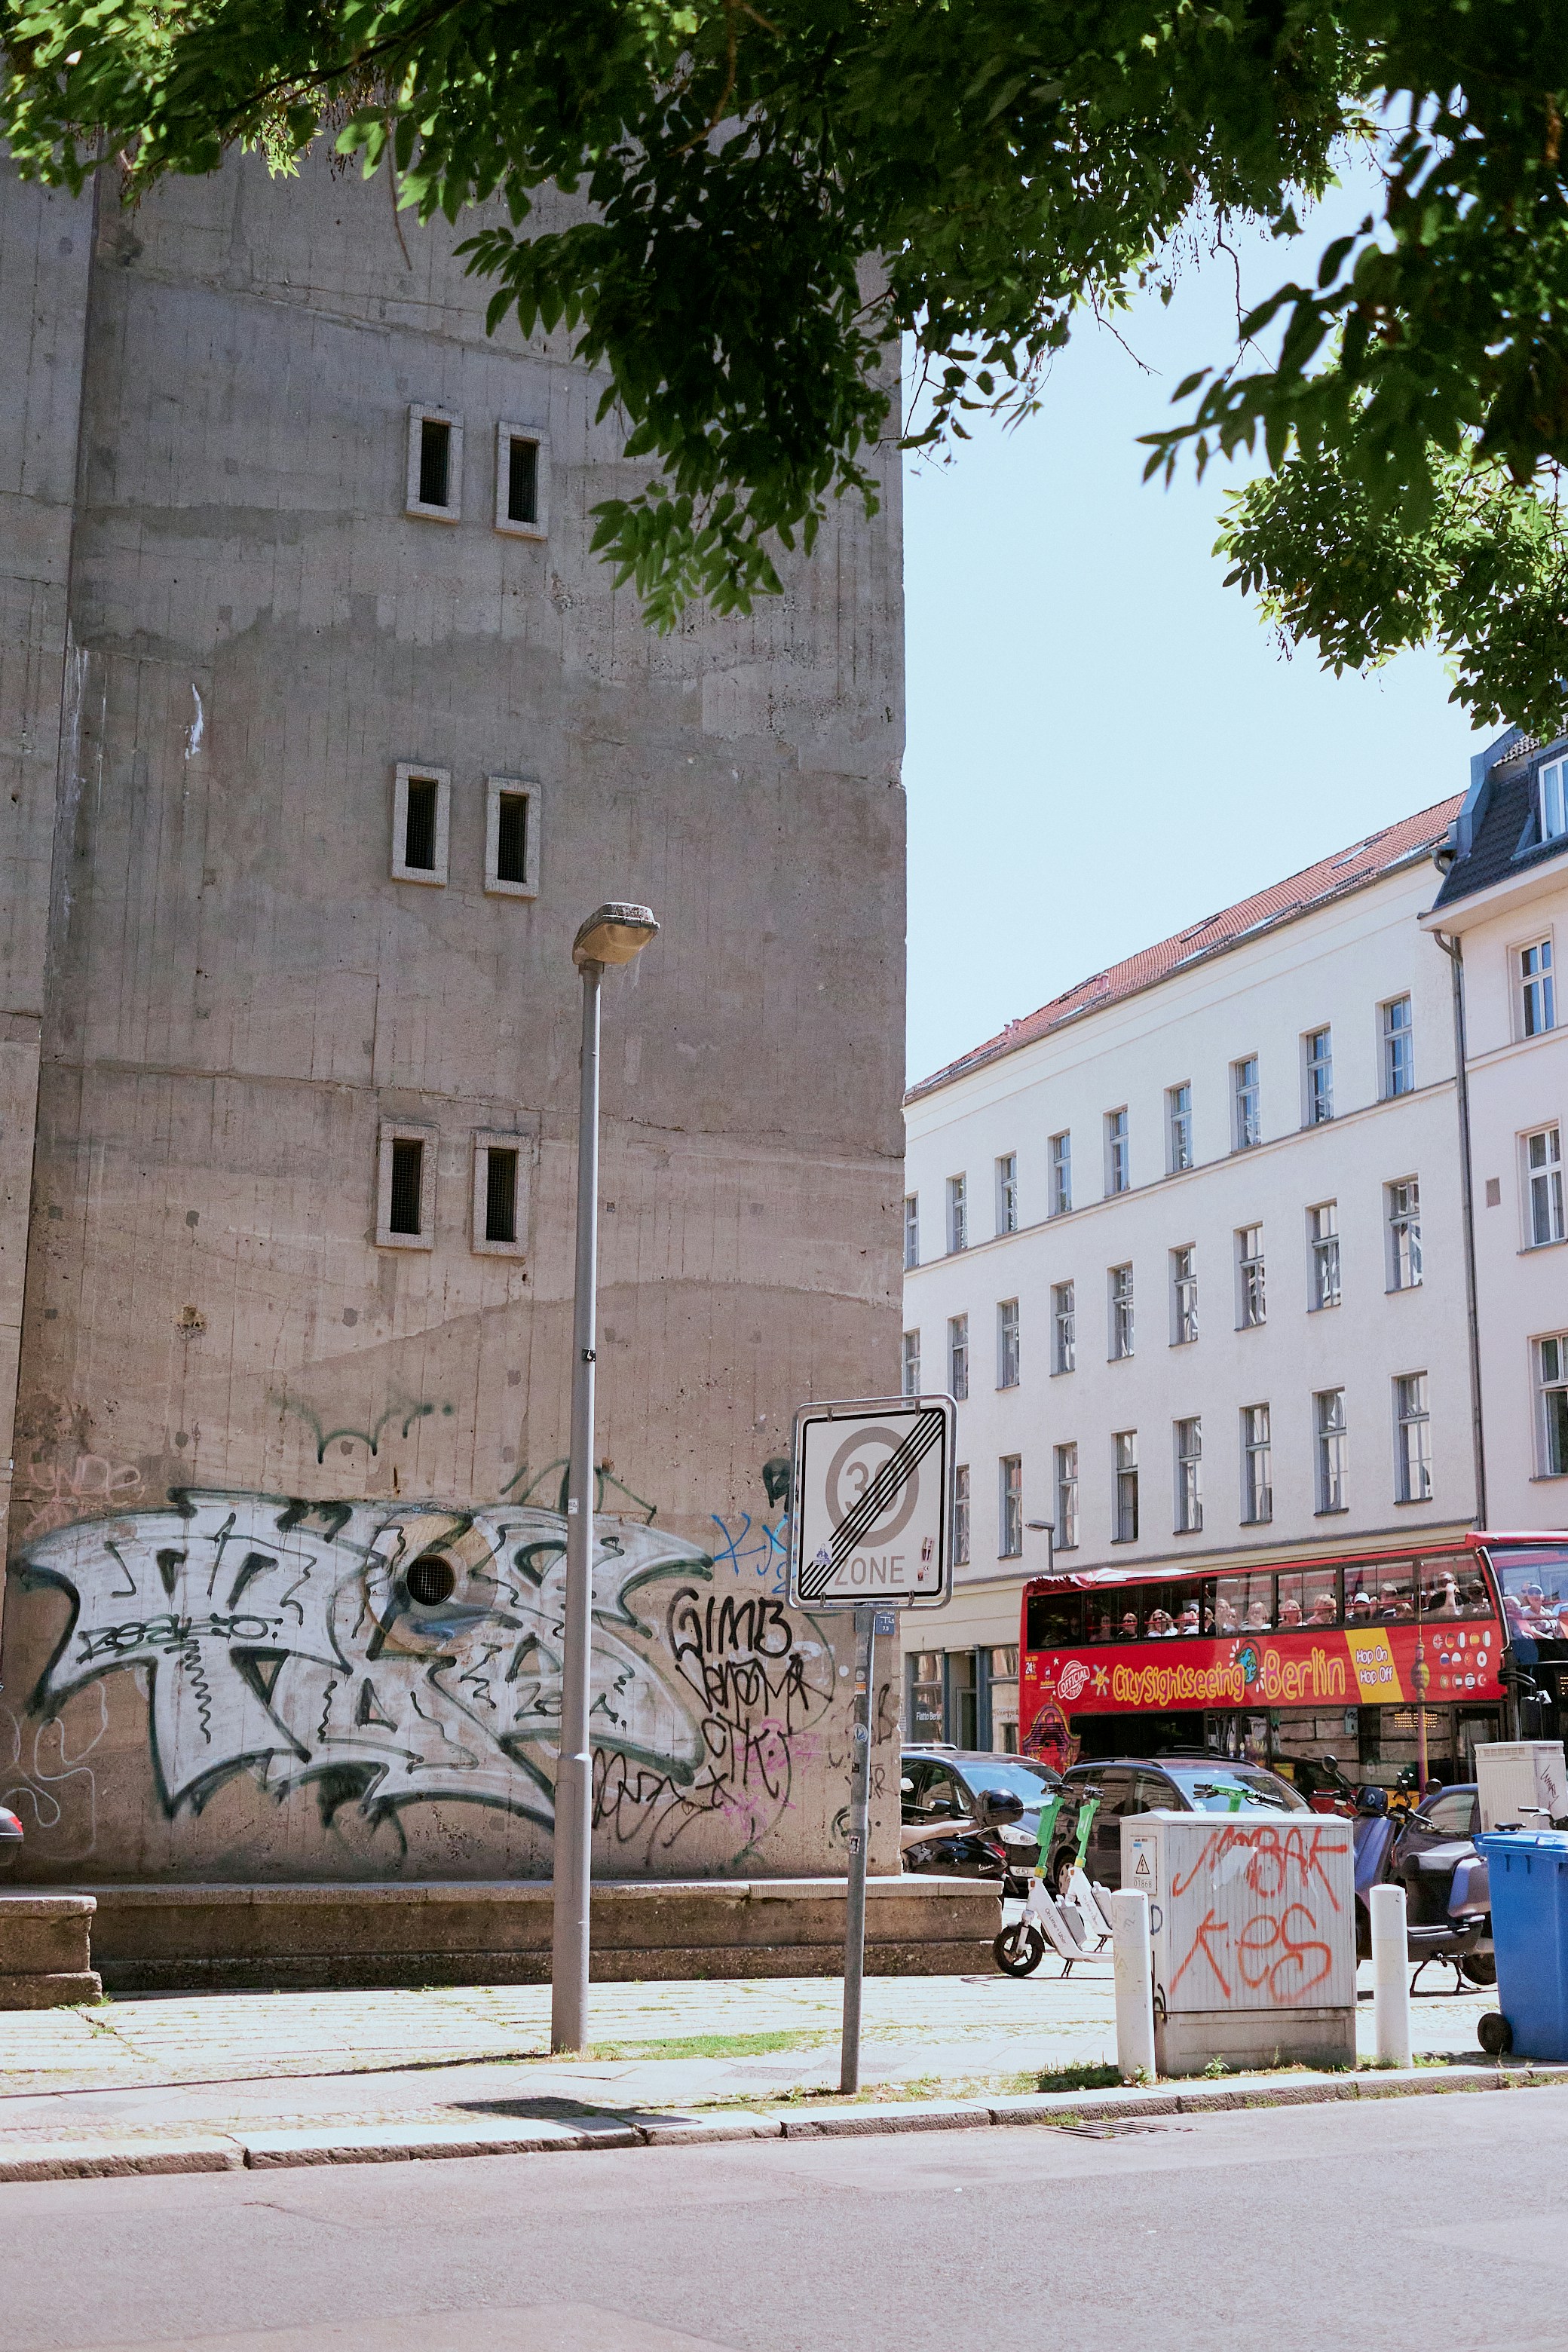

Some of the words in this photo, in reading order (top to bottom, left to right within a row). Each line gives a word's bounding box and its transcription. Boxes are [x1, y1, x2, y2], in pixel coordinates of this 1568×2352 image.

[845, 1459, 900, 1513] 30
[835, 1555, 905, 1586] ZONE
[1356, 1649, 1374, 1665] Hop
[1375, 1645, 1388, 1662] On
[1061, 1668, 1088, 1693] OFFICIAL
[1264, 1647, 1346, 1701] Berlin
[1360, 1669, 1377, 1686] Hop
[1379, 1665, 1393, 1683] Off
